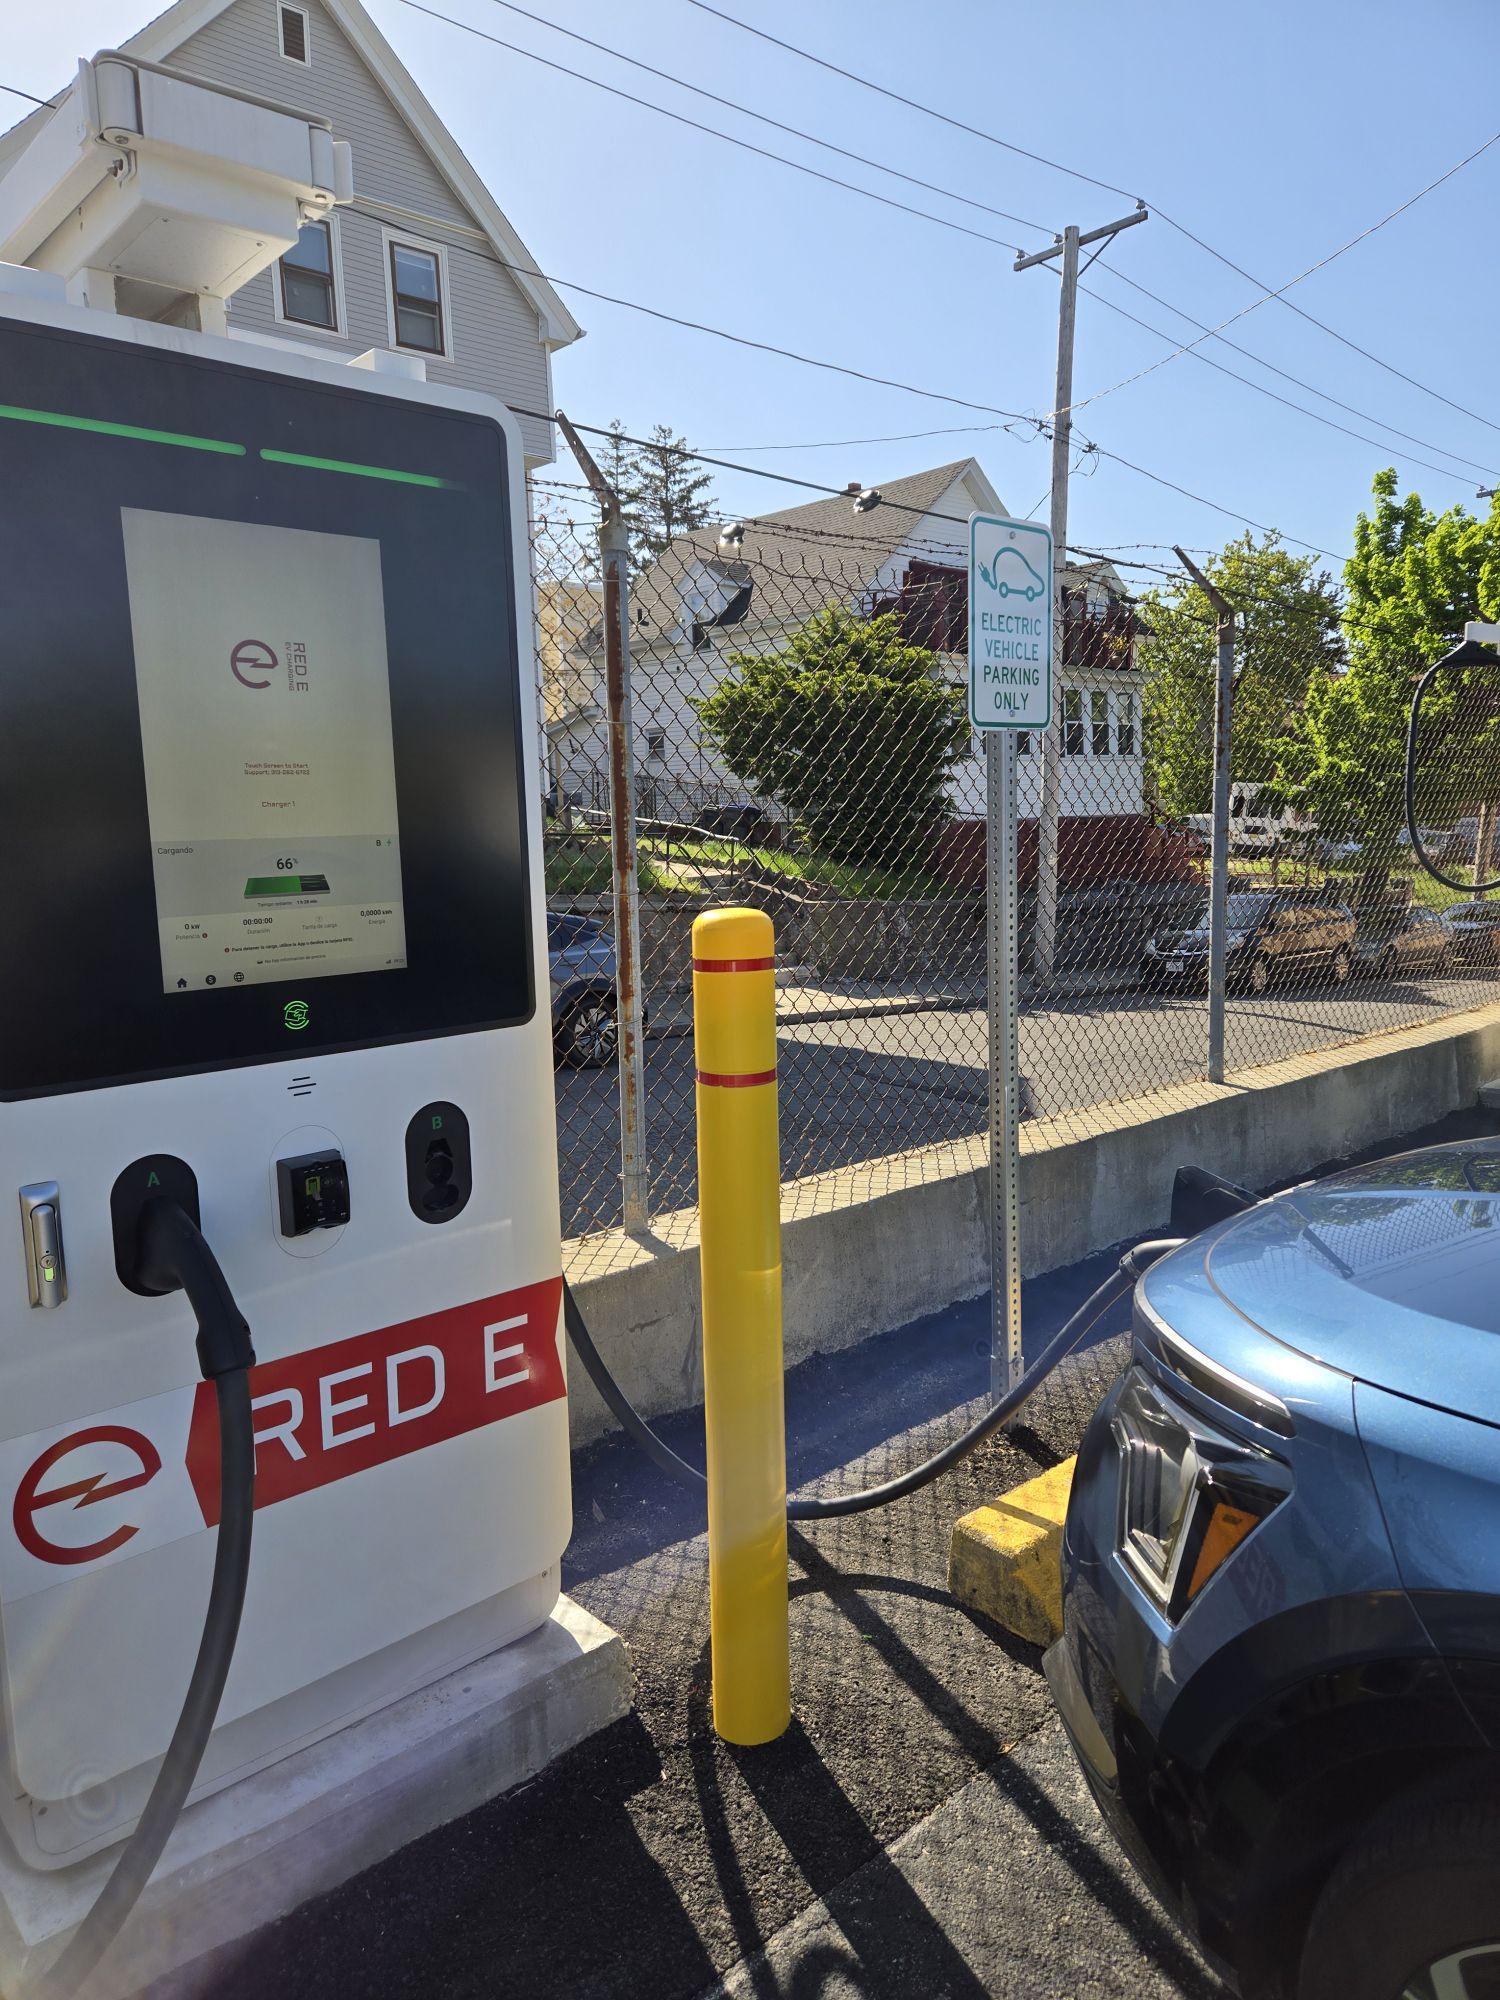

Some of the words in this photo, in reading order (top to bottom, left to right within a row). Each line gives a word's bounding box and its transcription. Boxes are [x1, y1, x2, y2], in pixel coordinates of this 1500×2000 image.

[981, 612, 1042, 636] ELECTRIC
[293, 642, 307, 676] RED
[985, 638, 1039, 662] VEHICLE
[983, 665, 1040, 686] PARKING
[296, 682, 308, 692] E
[994, 691, 1029, 711] ONLY
[157, 847, 194, 856] Cargando
[243, 917, 273, 925] 00:00:00
[431, 1116, 443, 1129] B
[146, 1171, 161, 1187] A
[254, 1344, 446, 1475] RED
[483, 1313, 530, 1394] E
